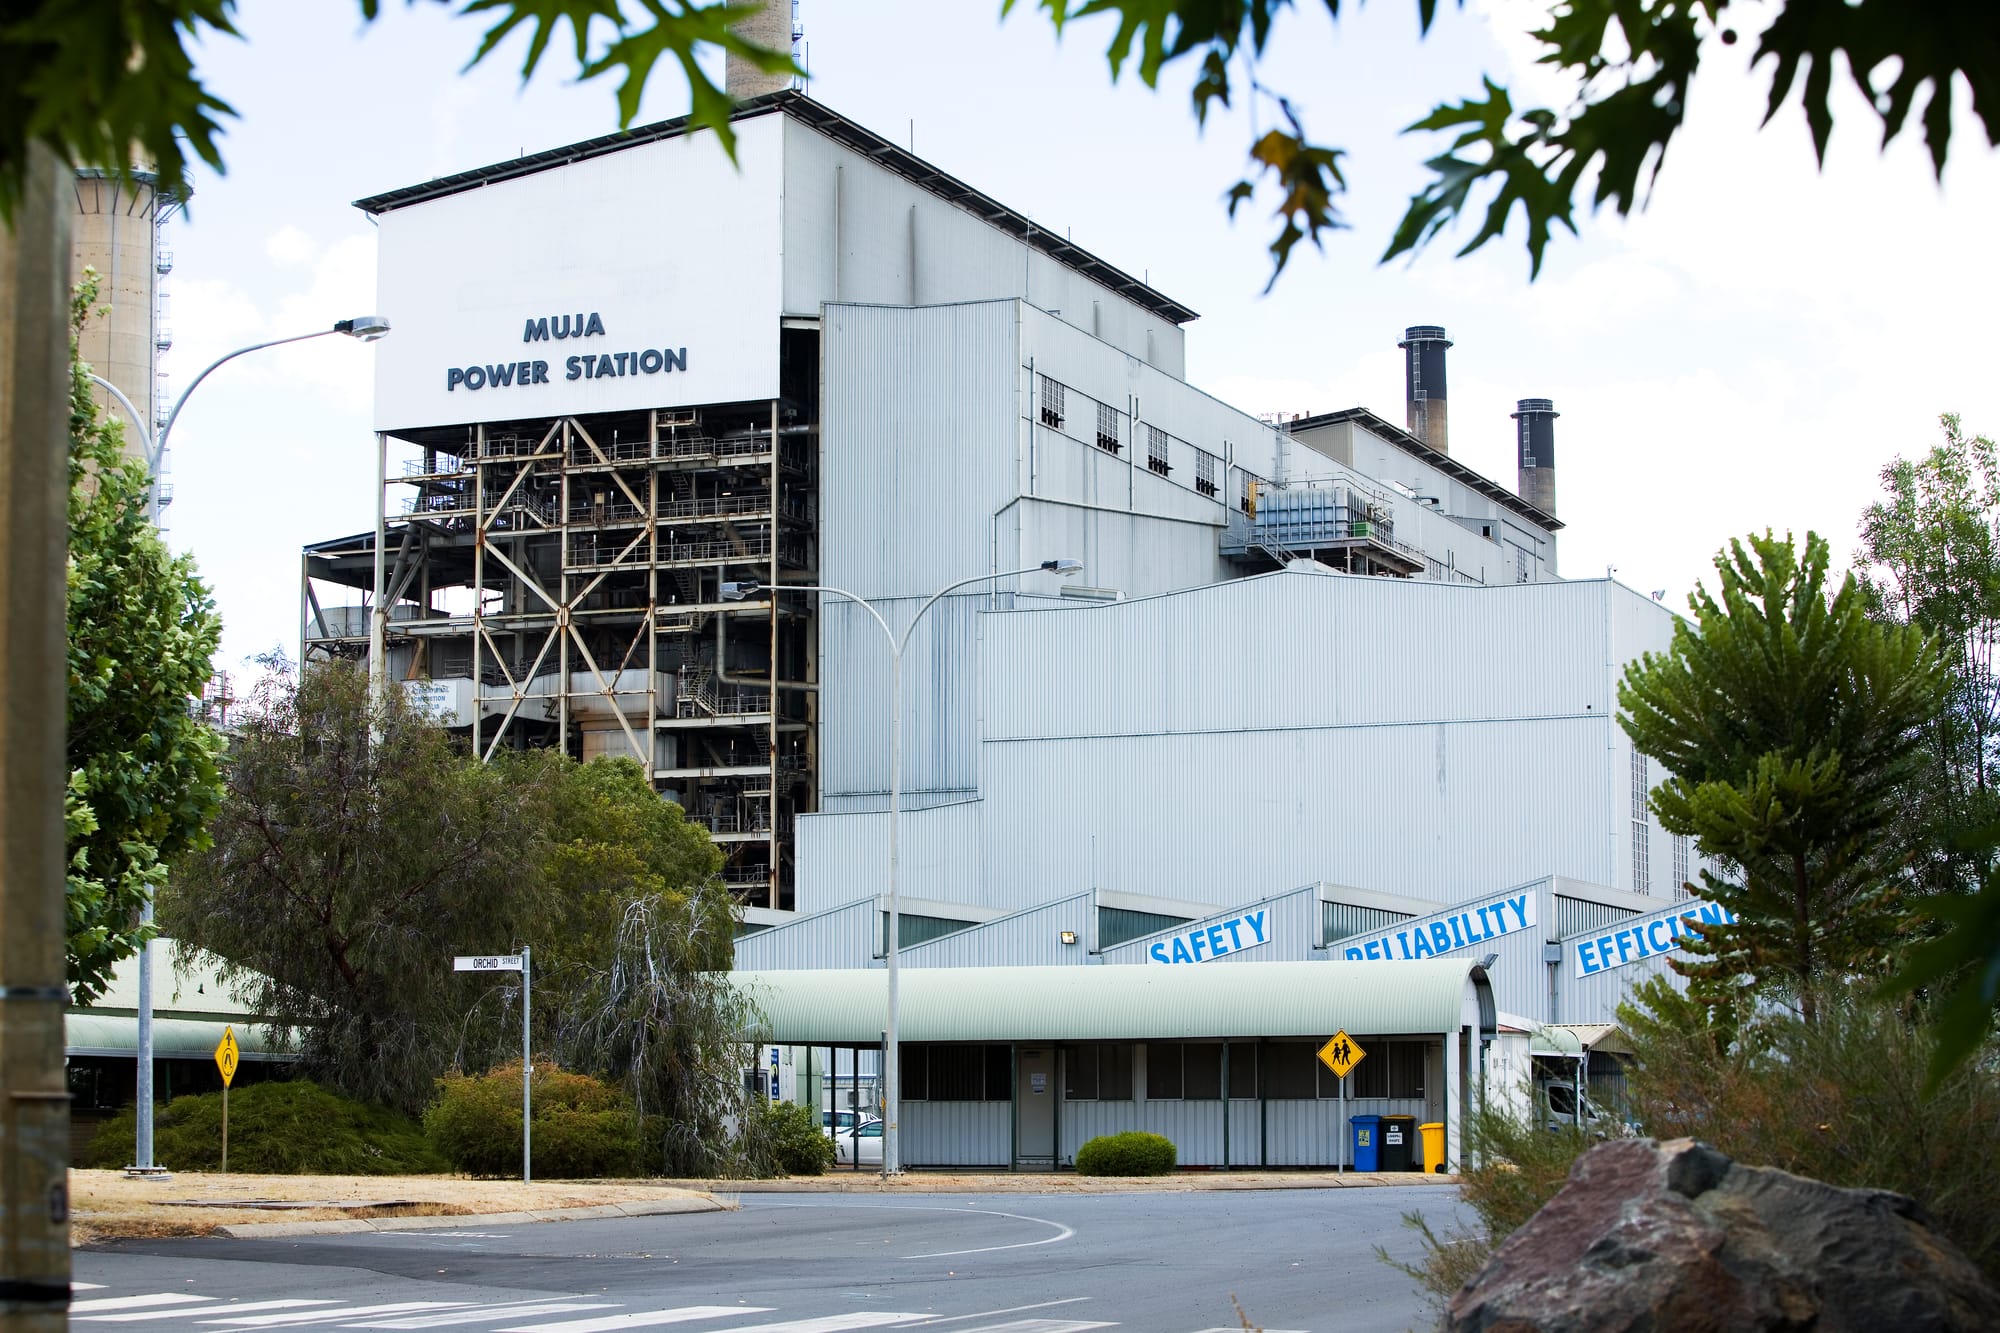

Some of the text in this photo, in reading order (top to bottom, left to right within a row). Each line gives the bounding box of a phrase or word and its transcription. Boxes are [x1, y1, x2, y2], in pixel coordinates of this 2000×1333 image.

[523, 312, 606, 343] MUJA
[447, 347, 687, 392] POWER STATION
[1150, 911, 1265, 964] SAFETY
[1578, 903, 1738, 974] EFFICIEN
[473, 957, 519, 969] ORCHID STREET
